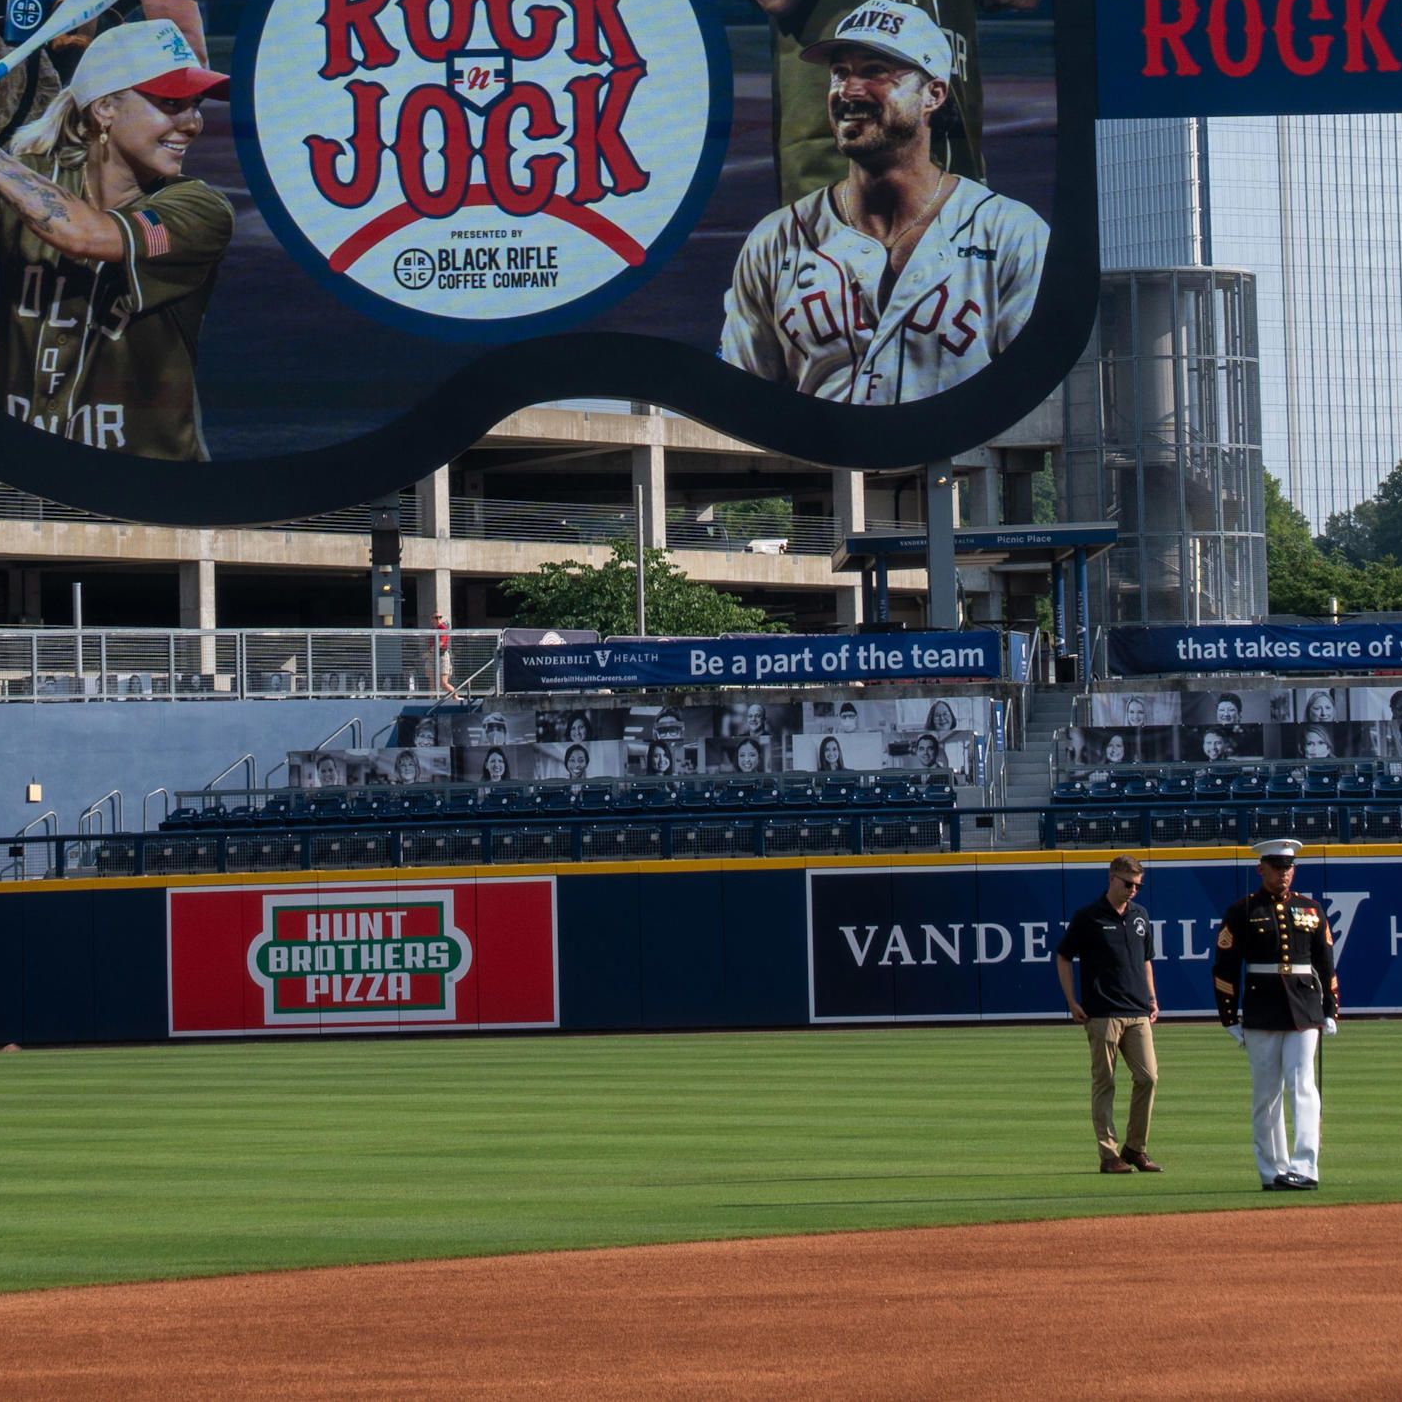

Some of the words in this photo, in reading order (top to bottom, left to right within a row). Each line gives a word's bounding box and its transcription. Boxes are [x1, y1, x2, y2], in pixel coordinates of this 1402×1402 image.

[302, 65, 651, 219] JOCK
[451, 230, 507, 239] PRESENTED
[511, 229, 523, 238] BY
[438, 248, 501, 272] BLACK
[507, 246, 558, 270] RIFLE
[438, 273, 487, 289] COFFEE
[493, 271, 559, 288] COMPANY
[997, 535, 1024, 544] Picnic
[1027, 535, 1052, 543] Place
[522, 654, 591, 666] VANDERBILT
[614, 653, 659, 663] HEALTH
[1177, 637, 1228, 660] that
[1234, 635, 1301, 658] takes
[1308, 640, 1361, 657] care
[1368, 635, 1394, 656] of
[690, 649, 724, 676] Be
[732, 656, 747, 674] a
[756, 647, 814, 679] part
[821, 645, 850, 671] of
[857, 643, 904, 670] the
[911, 644, 985, 669] team
[541, 674, 638, 684] VanderbiltHealthCareers.com
[307, 911, 407, 942] HUNT
[838, 919, 1224, 967] VANDEIL
[268, 942, 449, 972] BROTHERS
[306, 973, 411, 1003] PIZZA
